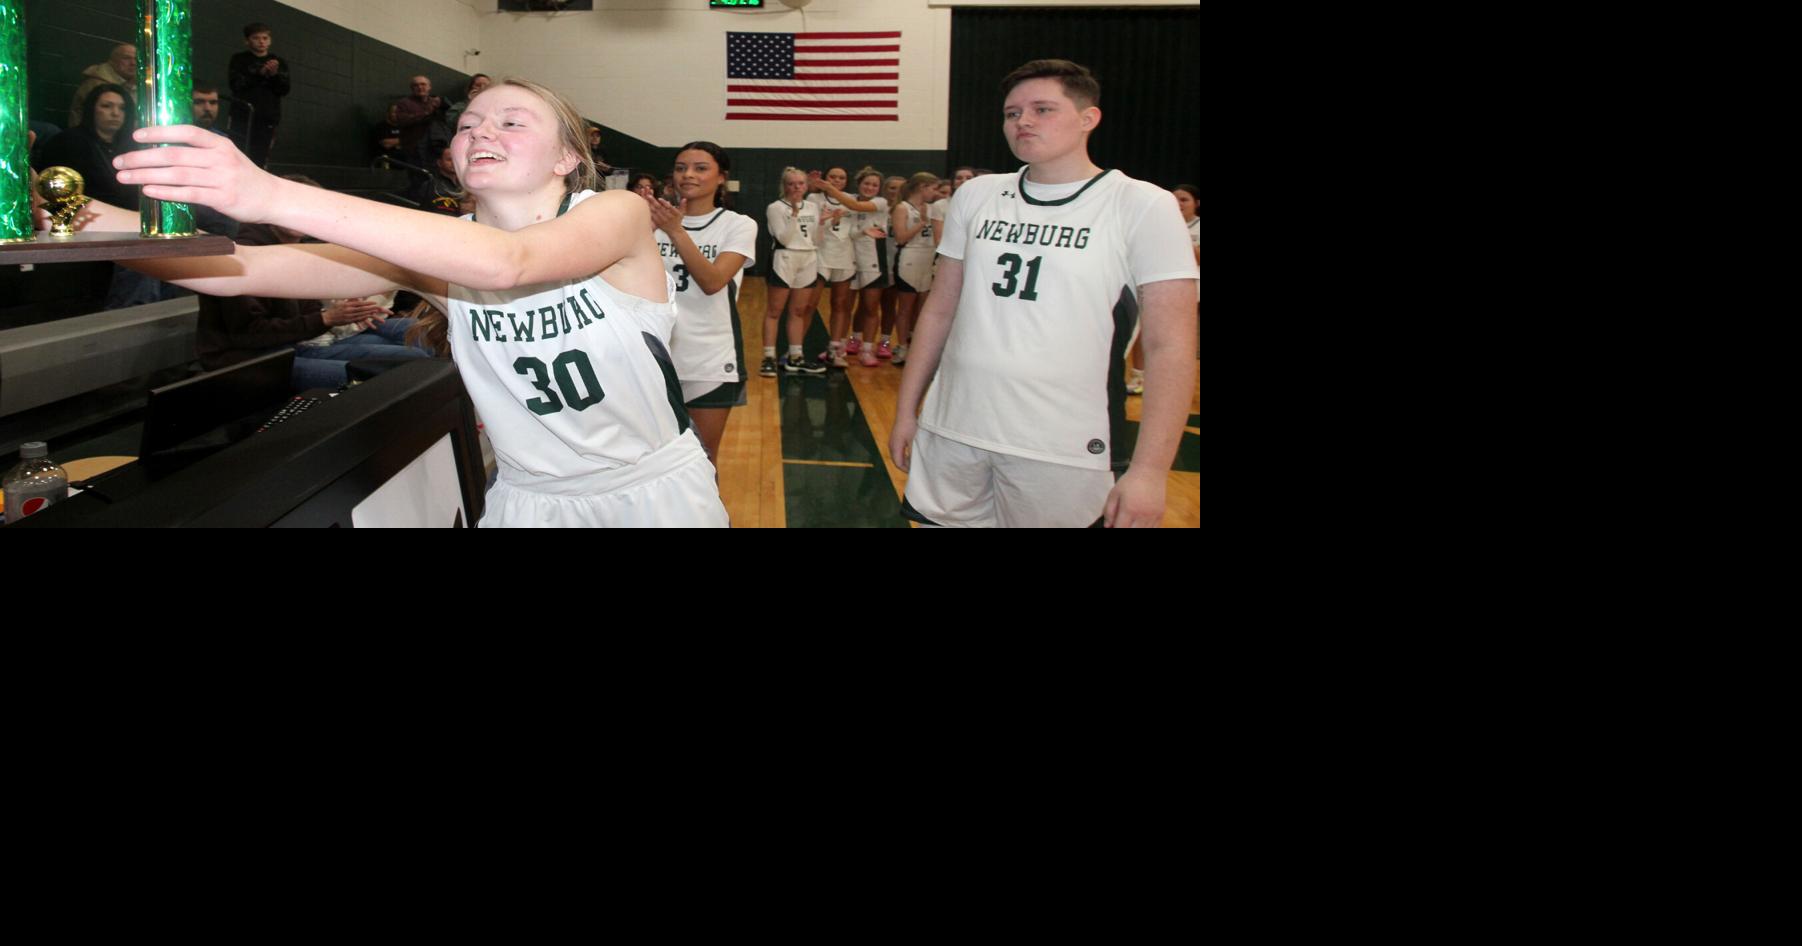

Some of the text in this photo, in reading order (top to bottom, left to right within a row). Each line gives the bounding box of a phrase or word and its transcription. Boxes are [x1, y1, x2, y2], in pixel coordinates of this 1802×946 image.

[976, 219, 1091, 249] NEWBURG
[673, 264, 689, 292] 3
[992, 252, 1042, 301] 31
[469, 288, 605, 342] NEWBURG
[513, 348, 605, 416] 30
